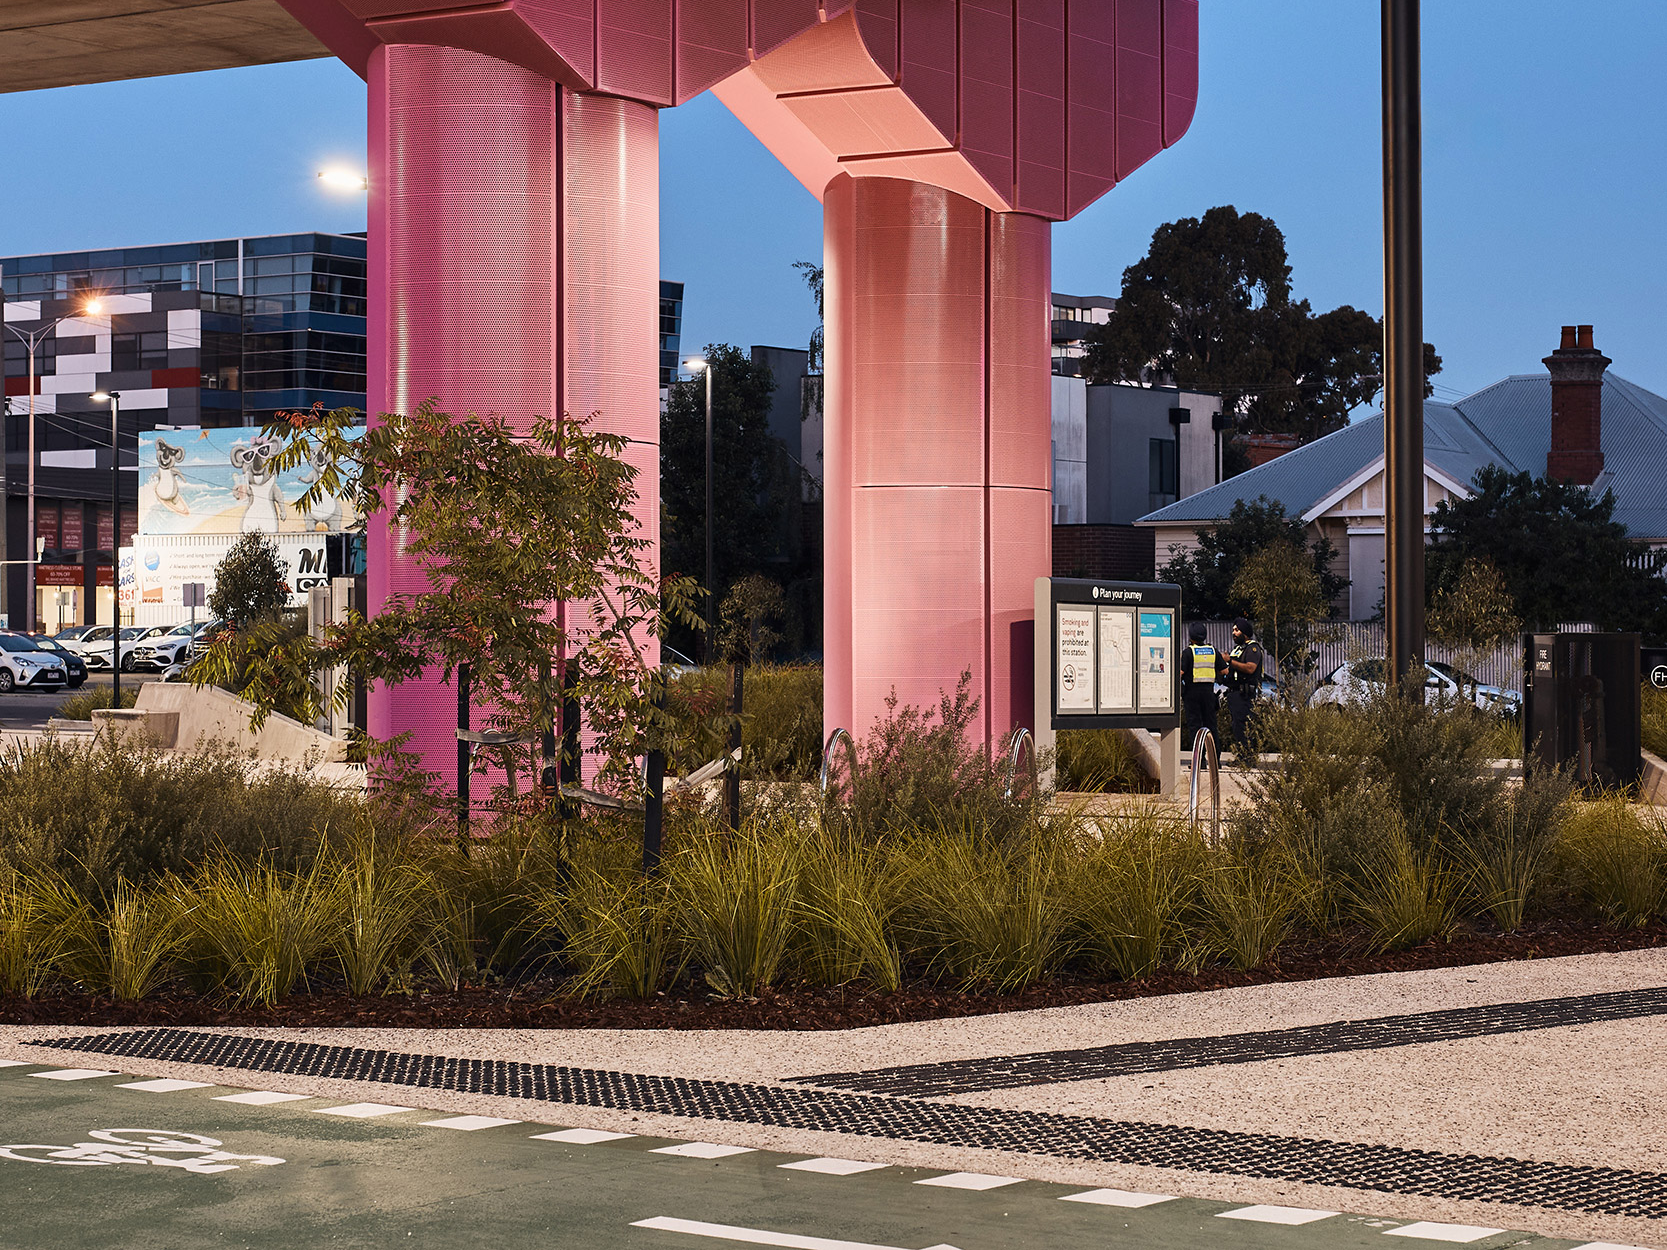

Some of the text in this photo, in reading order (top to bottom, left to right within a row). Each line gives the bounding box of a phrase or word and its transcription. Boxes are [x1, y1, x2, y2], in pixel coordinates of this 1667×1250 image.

[118, 555, 134, 570] ASH
[118, 572, 135, 587] ARS
[1100, 587, 1143, 602] Plan your journey
[1062, 617, 1089, 628] Smoking and
[1061, 628, 1076, 638] vaping
[1061, 638, 1083, 647] prohibited
[1062, 648, 1071, 656] this
[1539, 649, 1547, 660] FIRE
[1535, 661, 1551, 671] HYDRANT
